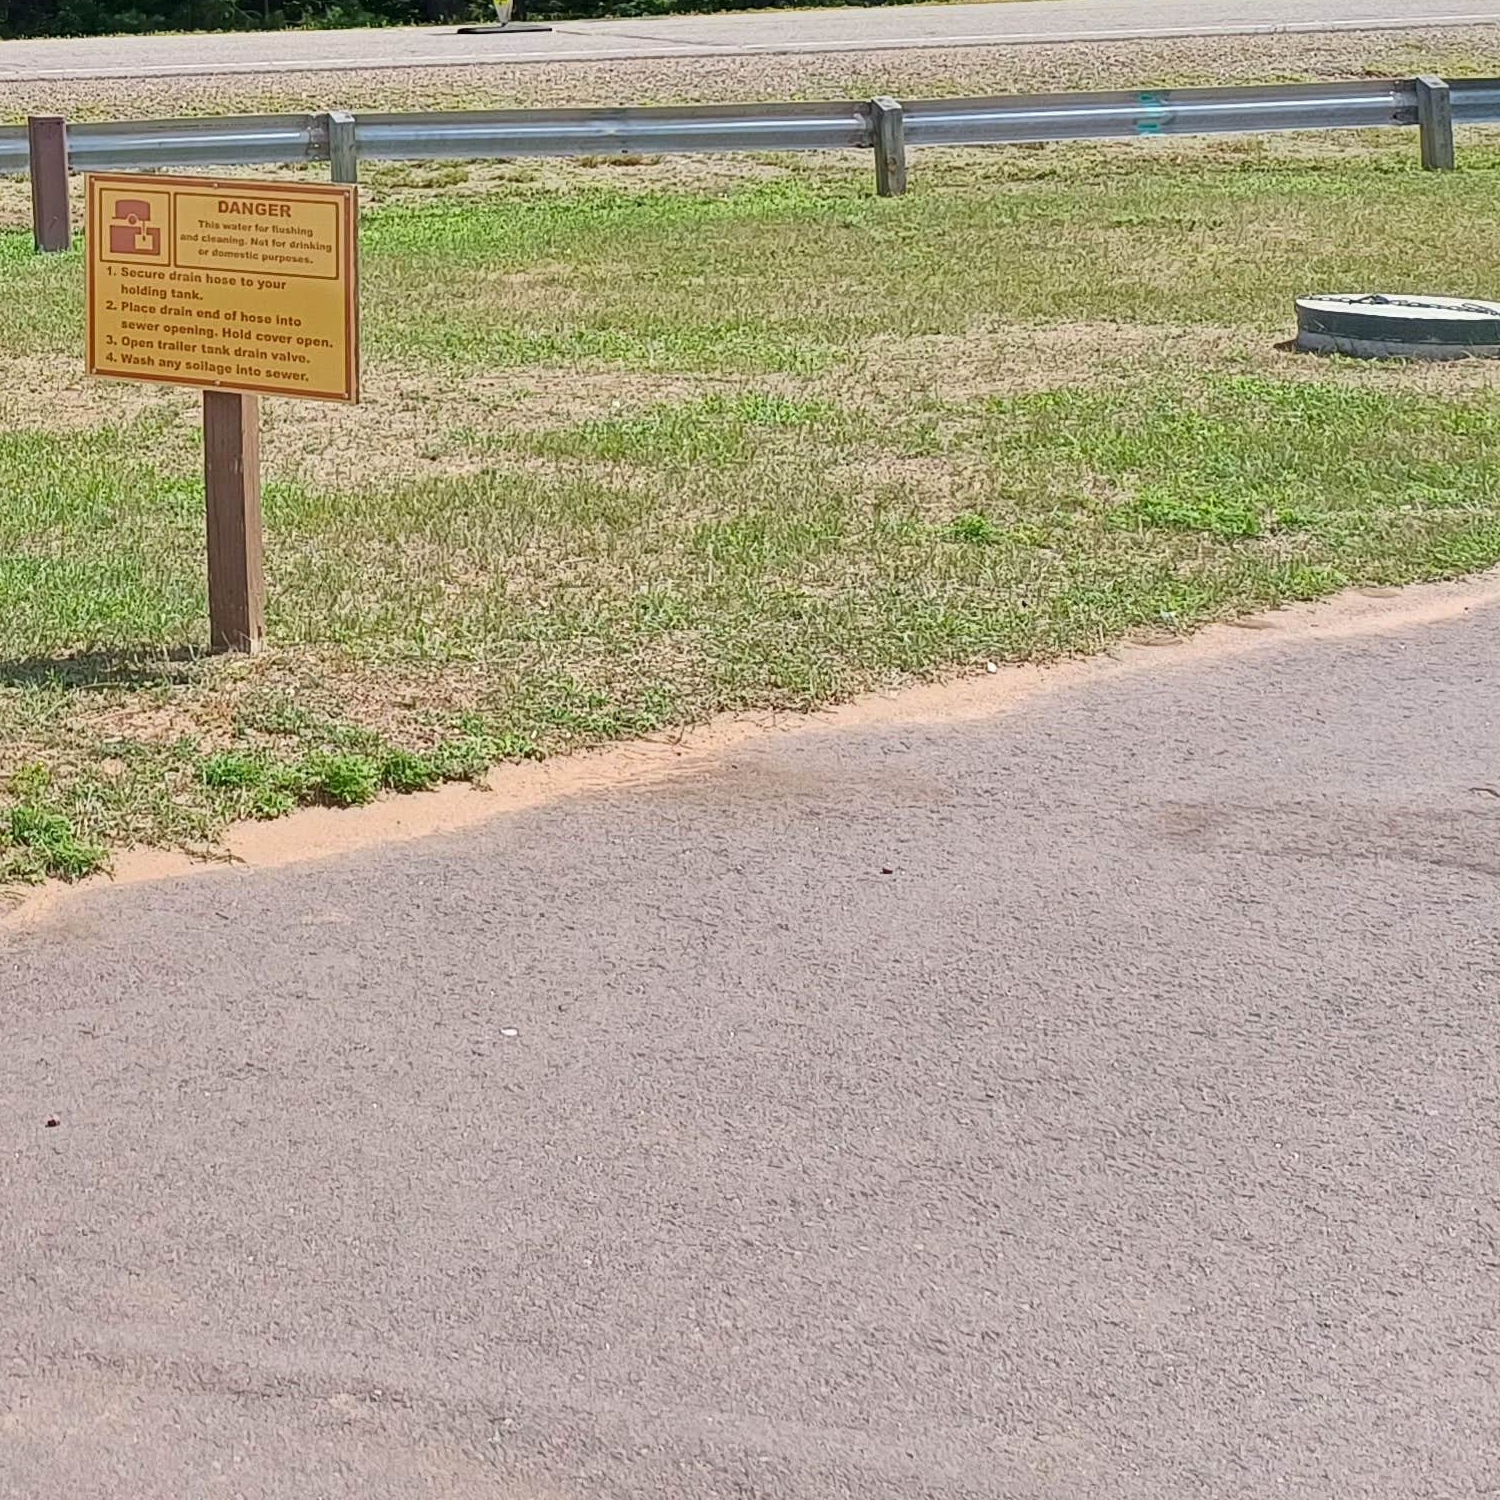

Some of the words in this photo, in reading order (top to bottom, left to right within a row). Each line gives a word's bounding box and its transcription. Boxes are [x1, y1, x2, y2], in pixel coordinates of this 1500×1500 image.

[218, 201, 292, 218] DANGER
[198, 220, 220, 229] This
[223, 223, 252, 232] water
[254, 223, 269, 232] for
[272, 225, 313, 237] flushing
[180, 232, 198, 241] and
[202, 234, 247, 246] cleaning.
[250, 238, 268, 246] Not
[272, 239, 287, 247] for
[290, 241, 332, 253] drinking
[212, 248, 259, 259] domestic
[262, 253, 313, 264] purposes.
[107, 267, 117, 276] 1.
[121, 267, 165, 279] Secure
[169, 271, 202, 283] drain
[205, 274, 236, 286] hose
[241, 277, 253, 287] to
[257, 280, 286, 290] your
[120, 285, 167, 299] holding
[171, 289, 203, 300] tank.
[106, 301, 117, 310] 2.
[121, 302, 156, 314] Place
[160, 305, 193, 317] drain
[197, 309, 220, 319] end
[224, 310, 237, 321] of
[240, 312, 272, 324] hose
[276, 315, 302, 327] into
[122, 320, 160, 330] sewer
[163, 325, 218, 338] opening.
[222, 328, 252, 340] Hold
[256, 333, 292, 343] cover
[296, 336, 333, 348] open.
[106, 335, 117, 346] 3.
[122, 337, 154, 349] Open
[158, 340, 196, 353] trailer
[202, 344, 230, 356] tank
[234, 347, 267, 360] drain
[271, 351, 311, 364] valve.
[106, 352, 117, 362] 4.
[121, 354, 155, 366] Wash
[158, 359, 182, 371] any
[185, 361, 232, 375] soilage
[236, 364, 261, 377] into
[265, 370, 309, 382] sewer.
